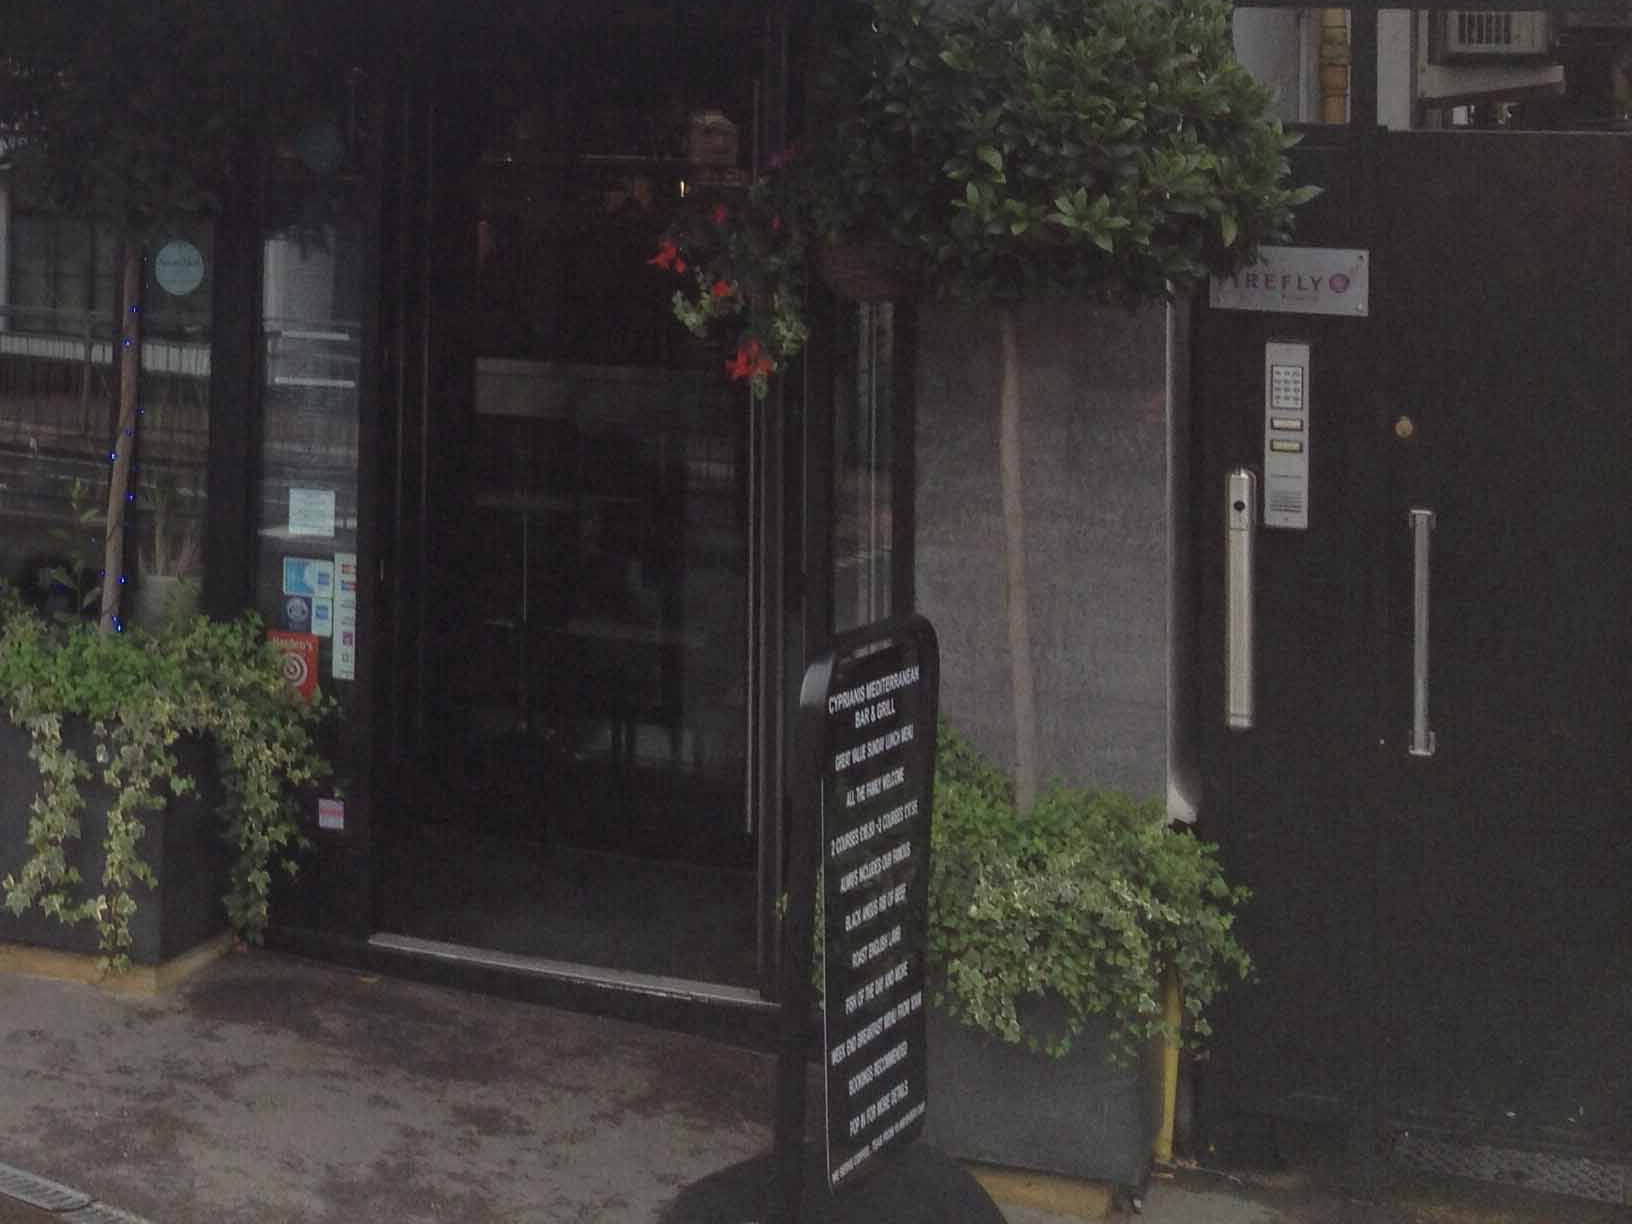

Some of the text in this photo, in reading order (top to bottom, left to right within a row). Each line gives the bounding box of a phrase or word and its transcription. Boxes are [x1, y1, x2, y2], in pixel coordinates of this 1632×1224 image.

[829, 685, 865, 715] CYPRIANIS
[855, 707, 869, 729] BAR
[877, 697, 895, 719] GRILL
